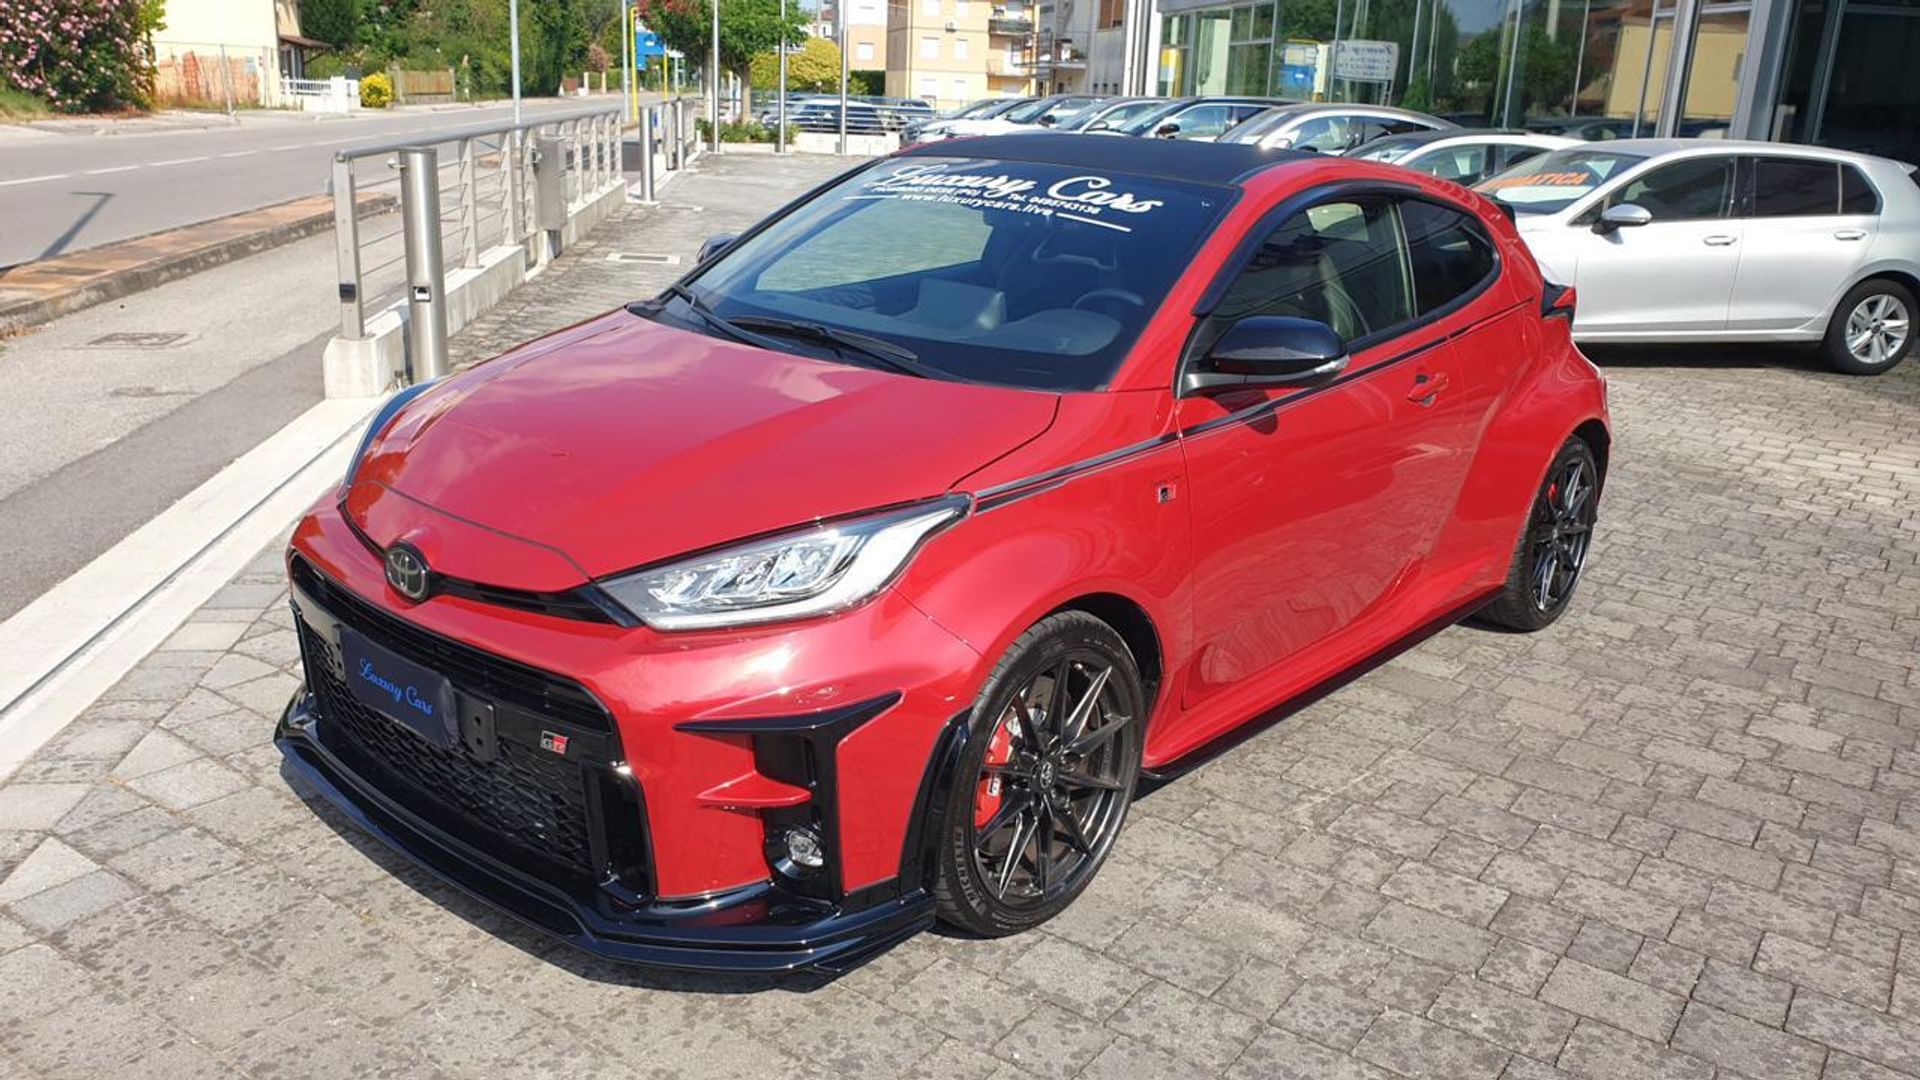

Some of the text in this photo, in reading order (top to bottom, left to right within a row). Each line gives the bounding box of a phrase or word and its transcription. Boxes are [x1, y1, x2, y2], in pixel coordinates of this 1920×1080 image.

[865, 164, 1163, 213] Luxury Cars
[902, 194, 1054, 216] www.luxurycars.live
[359, 658, 433, 715] Luxury Cars
